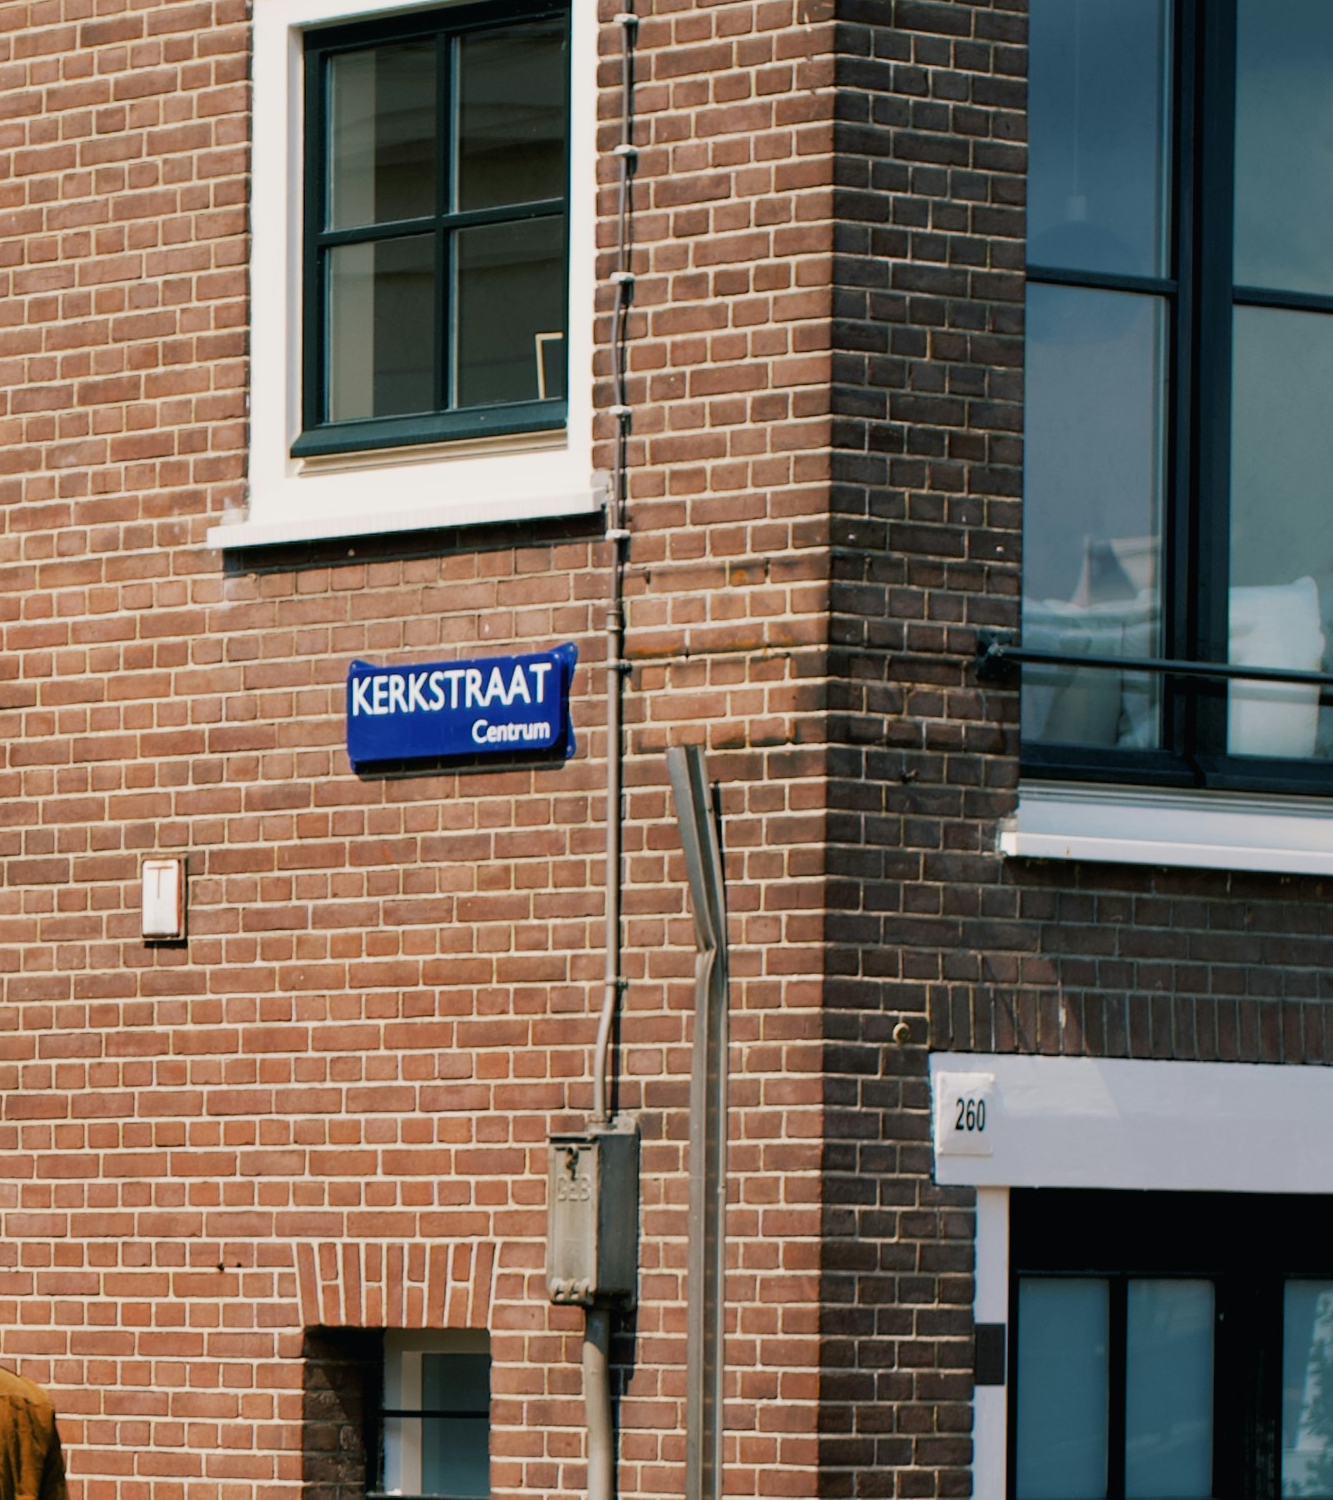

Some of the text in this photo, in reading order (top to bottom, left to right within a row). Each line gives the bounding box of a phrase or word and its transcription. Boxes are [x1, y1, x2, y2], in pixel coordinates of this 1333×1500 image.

[352, 663, 552, 717] KERKSTRAAT
[471, 719, 551, 744] Centrum
[954, 1097, 986, 1132] 260
